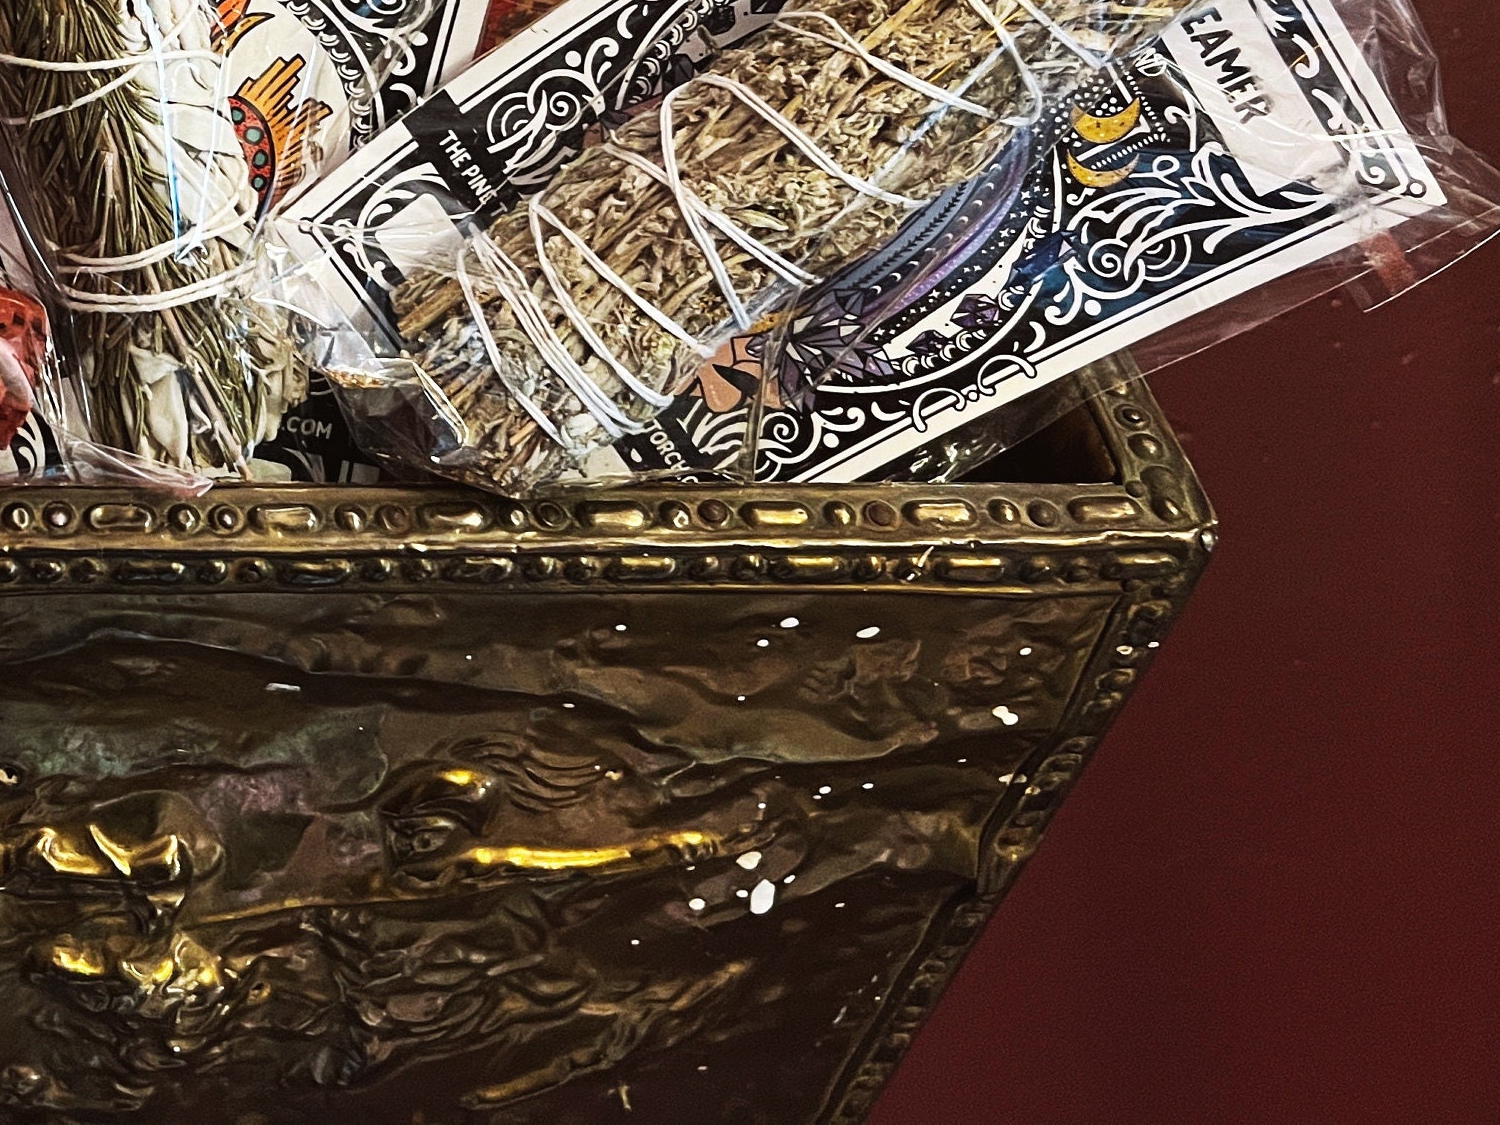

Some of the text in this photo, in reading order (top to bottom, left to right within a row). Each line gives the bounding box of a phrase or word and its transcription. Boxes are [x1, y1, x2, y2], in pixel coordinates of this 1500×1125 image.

[1180, 6, 1275, 124] EAMER
[439, 129, 498, 205] THE PINE
[281, 416, 333, 440] .COM
